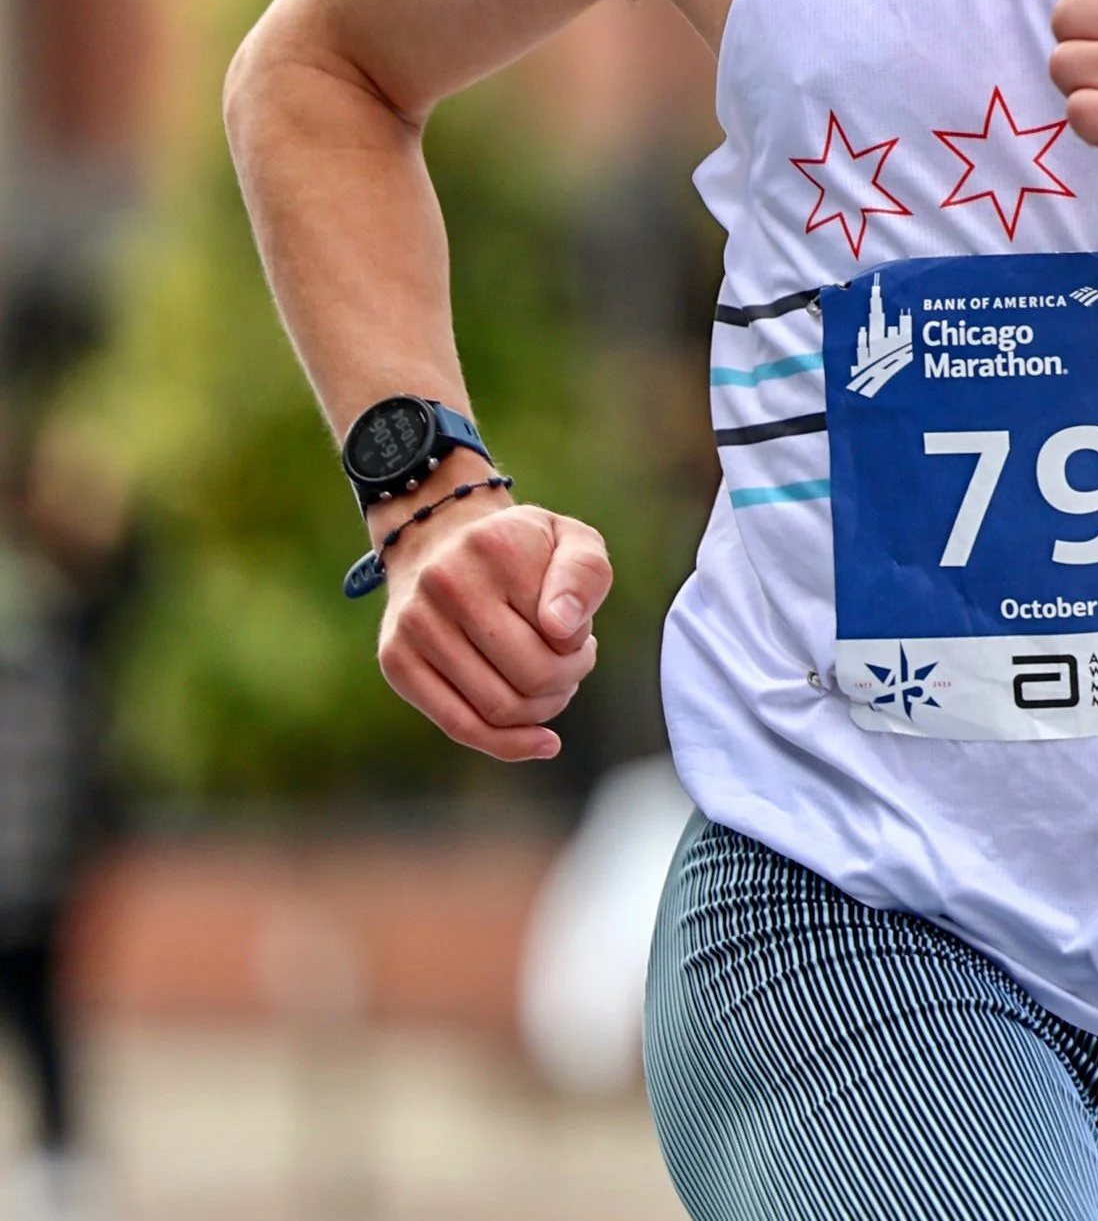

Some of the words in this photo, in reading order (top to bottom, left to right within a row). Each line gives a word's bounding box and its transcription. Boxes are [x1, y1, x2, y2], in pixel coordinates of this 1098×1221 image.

[923, 298, 967, 311] BANK
[970, 297, 990, 310] OF
[993, 295, 1067, 309] AMERICA
[922, 320, 1034, 352] Chicago
[1000, 596, 1098, 619] October
